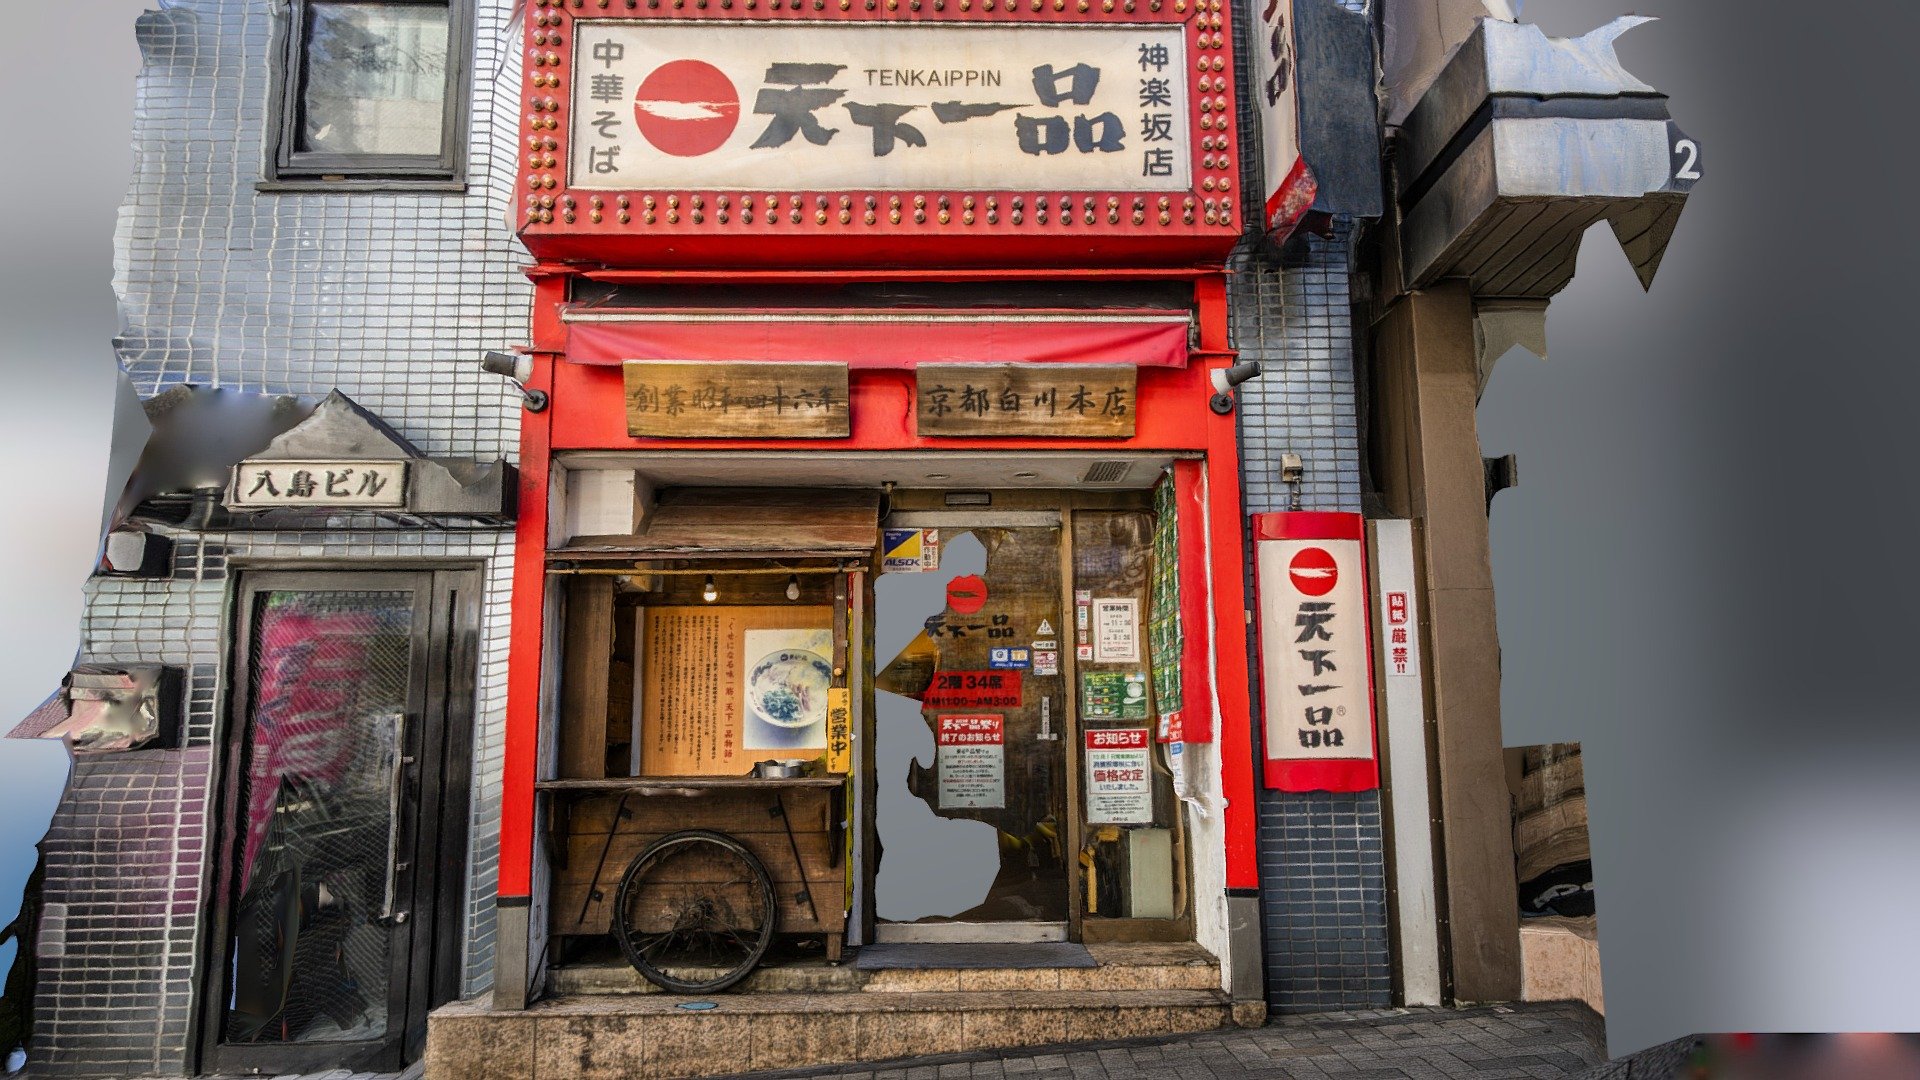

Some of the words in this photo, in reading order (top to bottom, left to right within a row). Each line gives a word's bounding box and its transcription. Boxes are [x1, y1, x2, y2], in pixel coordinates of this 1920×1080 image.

[863, 69, 1002, 88] TENKAIPPIN
[588, 38, 625, 174] 中華そば
[748, 62, 1127, 157] 天下一品
[1138, 43, 1173, 177] 神楽坂店
[1675, 139, 1700, 179] 2
[631, 379, 838, 415] 創業昭和四十六年
[925, 383, 1130, 417] 京都白川本店
[248, 468, 388, 498] 八島ビル
[884, 558, 920, 566] ALSOK
[938, 675, 962, 690] 2階
[966, 675, 1003, 690] 34席
[1294, 602, 1344, 748] 天下一品
[831, 706, 848, 757] 営業中
[941, 732, 1001, 743] 終了のお知らせ
[1093, 732, 1142, 745] お知らせ
[1094, 769, 1144, 782] 価格改定
